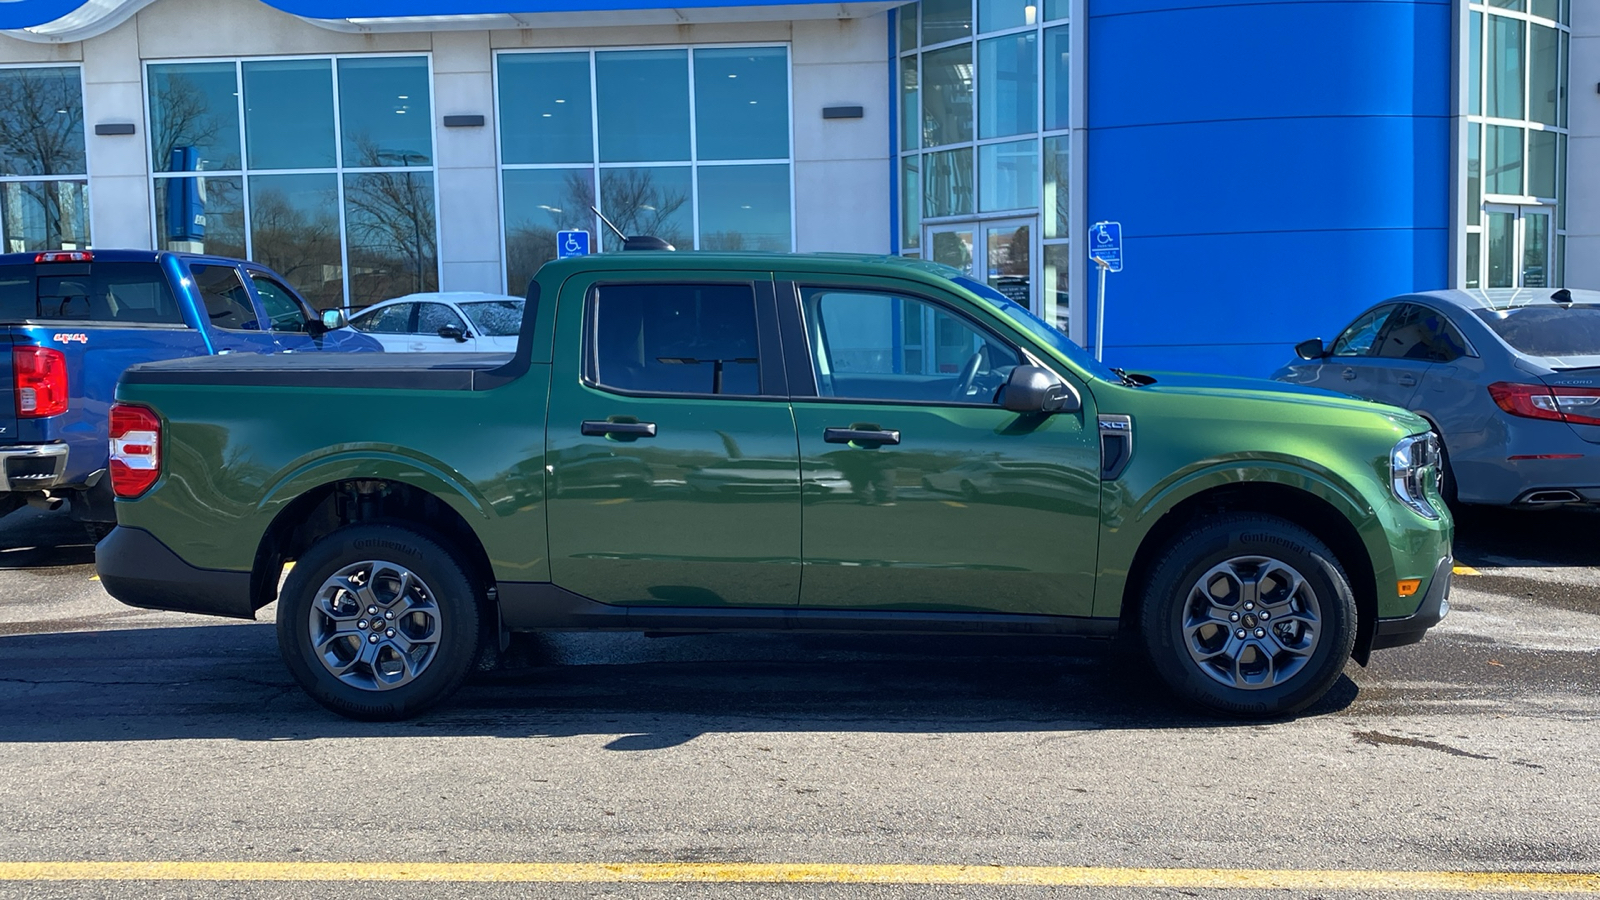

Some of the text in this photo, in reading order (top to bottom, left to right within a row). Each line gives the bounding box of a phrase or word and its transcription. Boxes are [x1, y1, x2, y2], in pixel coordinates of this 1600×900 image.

[1100, 421, 1128, 429] XLT
[353, 538, 417, 555] Continental
[1239, 532, 1306, 554] Continental
